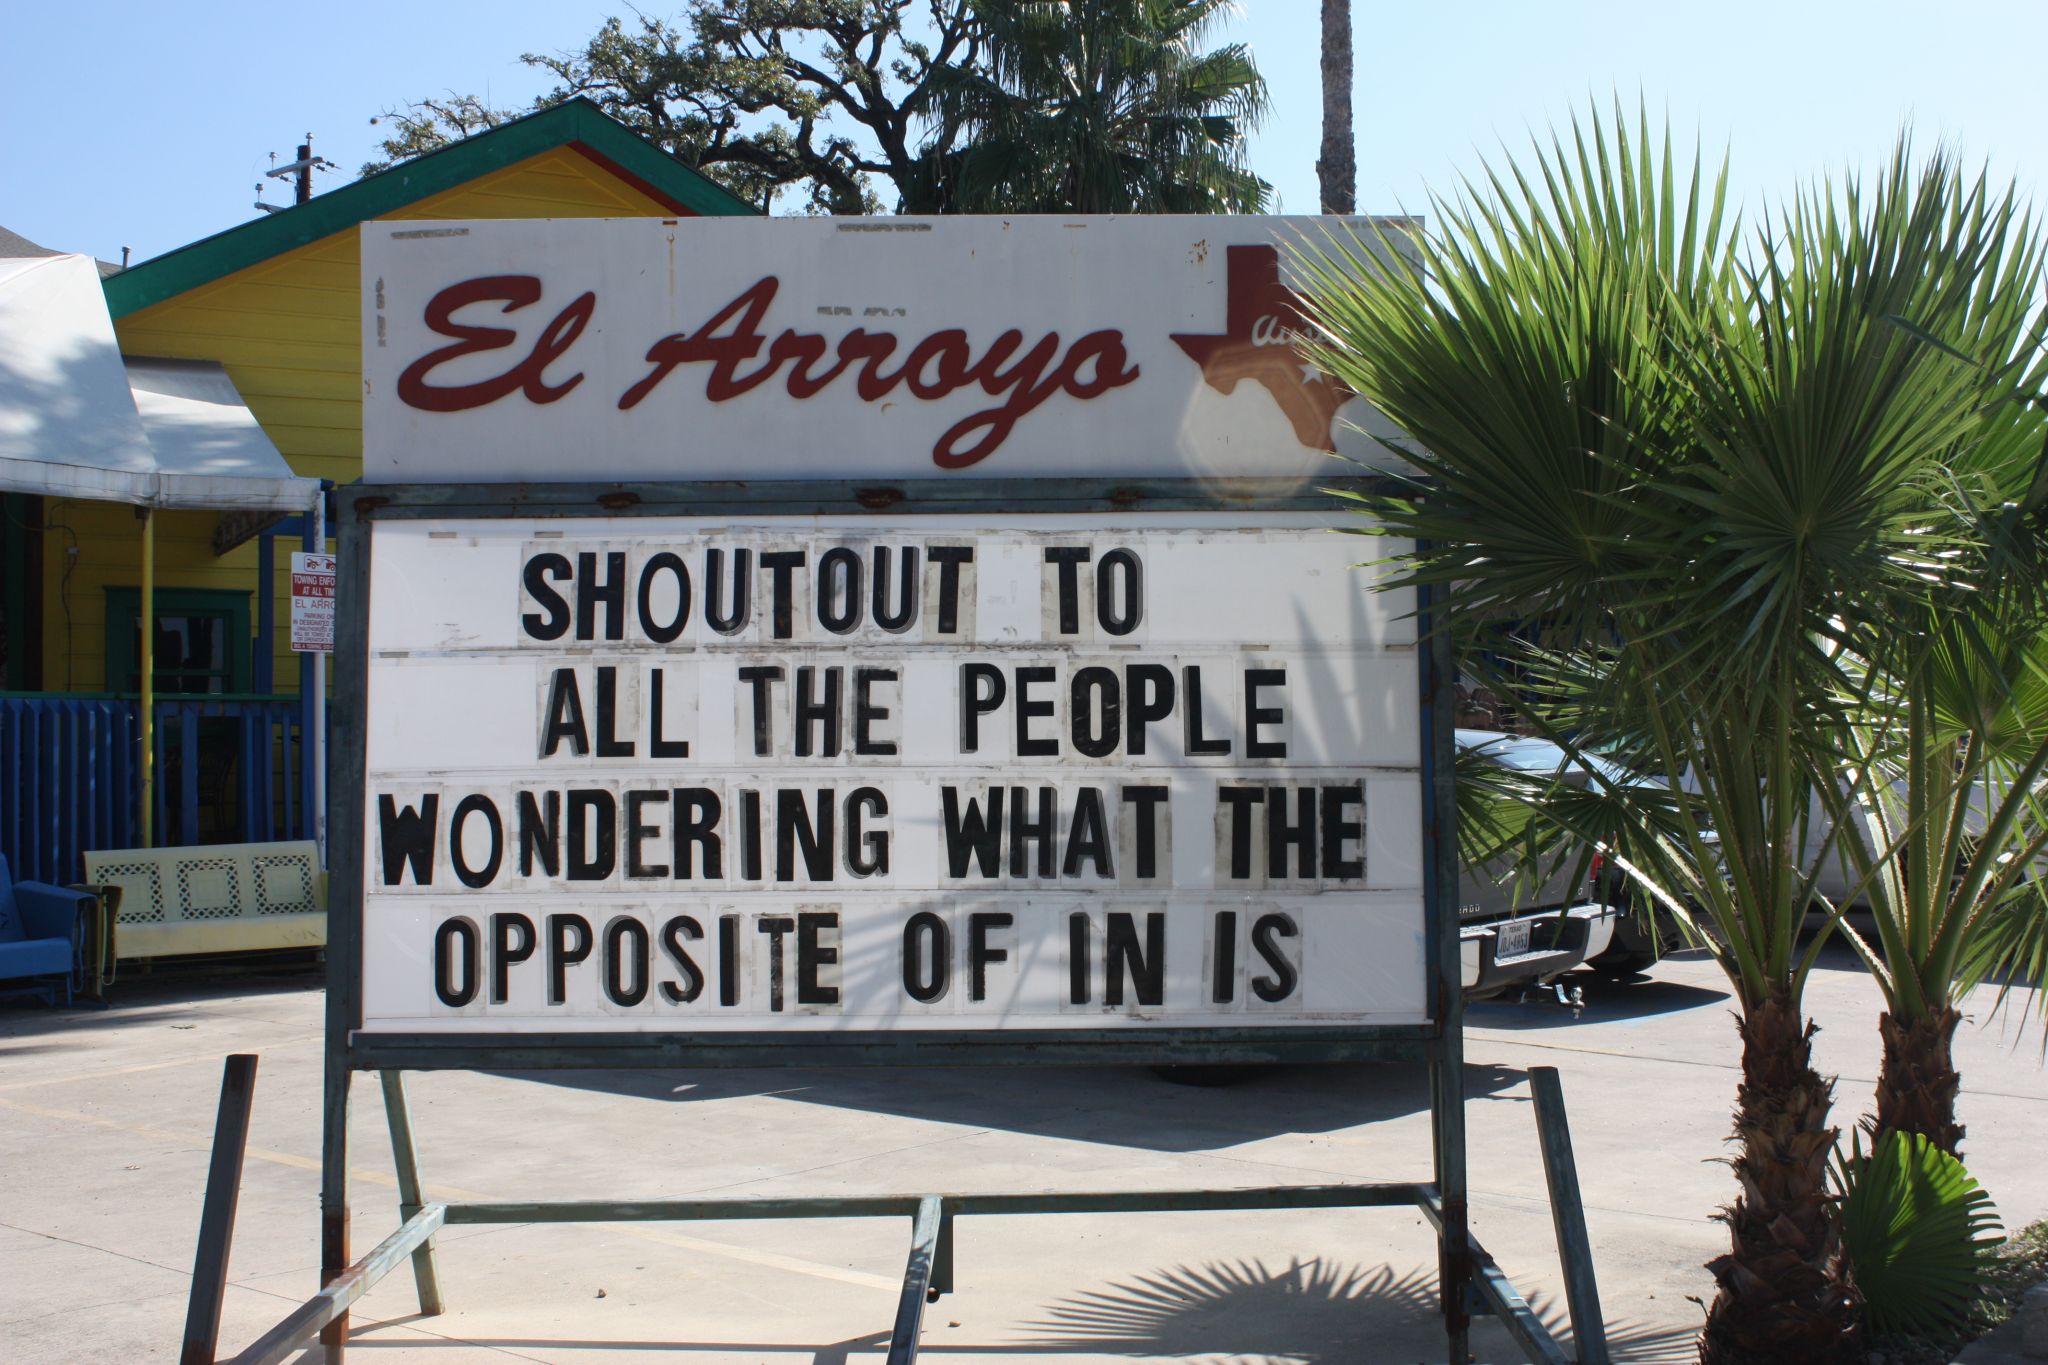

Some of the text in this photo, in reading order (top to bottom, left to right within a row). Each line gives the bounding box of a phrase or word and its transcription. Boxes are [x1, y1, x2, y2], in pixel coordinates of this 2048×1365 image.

[399, 276, 1140, 469] El Arroyo
[293, 575, 318, 585] TOWING
[295, 599, 307, 608] EL
[303, 586, 310, 595] AT
[312, 587, 322, 595] ALL
[522, 545, 1143, 644] SHOUTOUT TO
[540, 662, 1288, 760] ALL THE PEOPLE
[379, 785, 1367, 890] WONDERING WHAT THE
[434, 911, 1300, 1013] OPPOSITE OF IN IS
